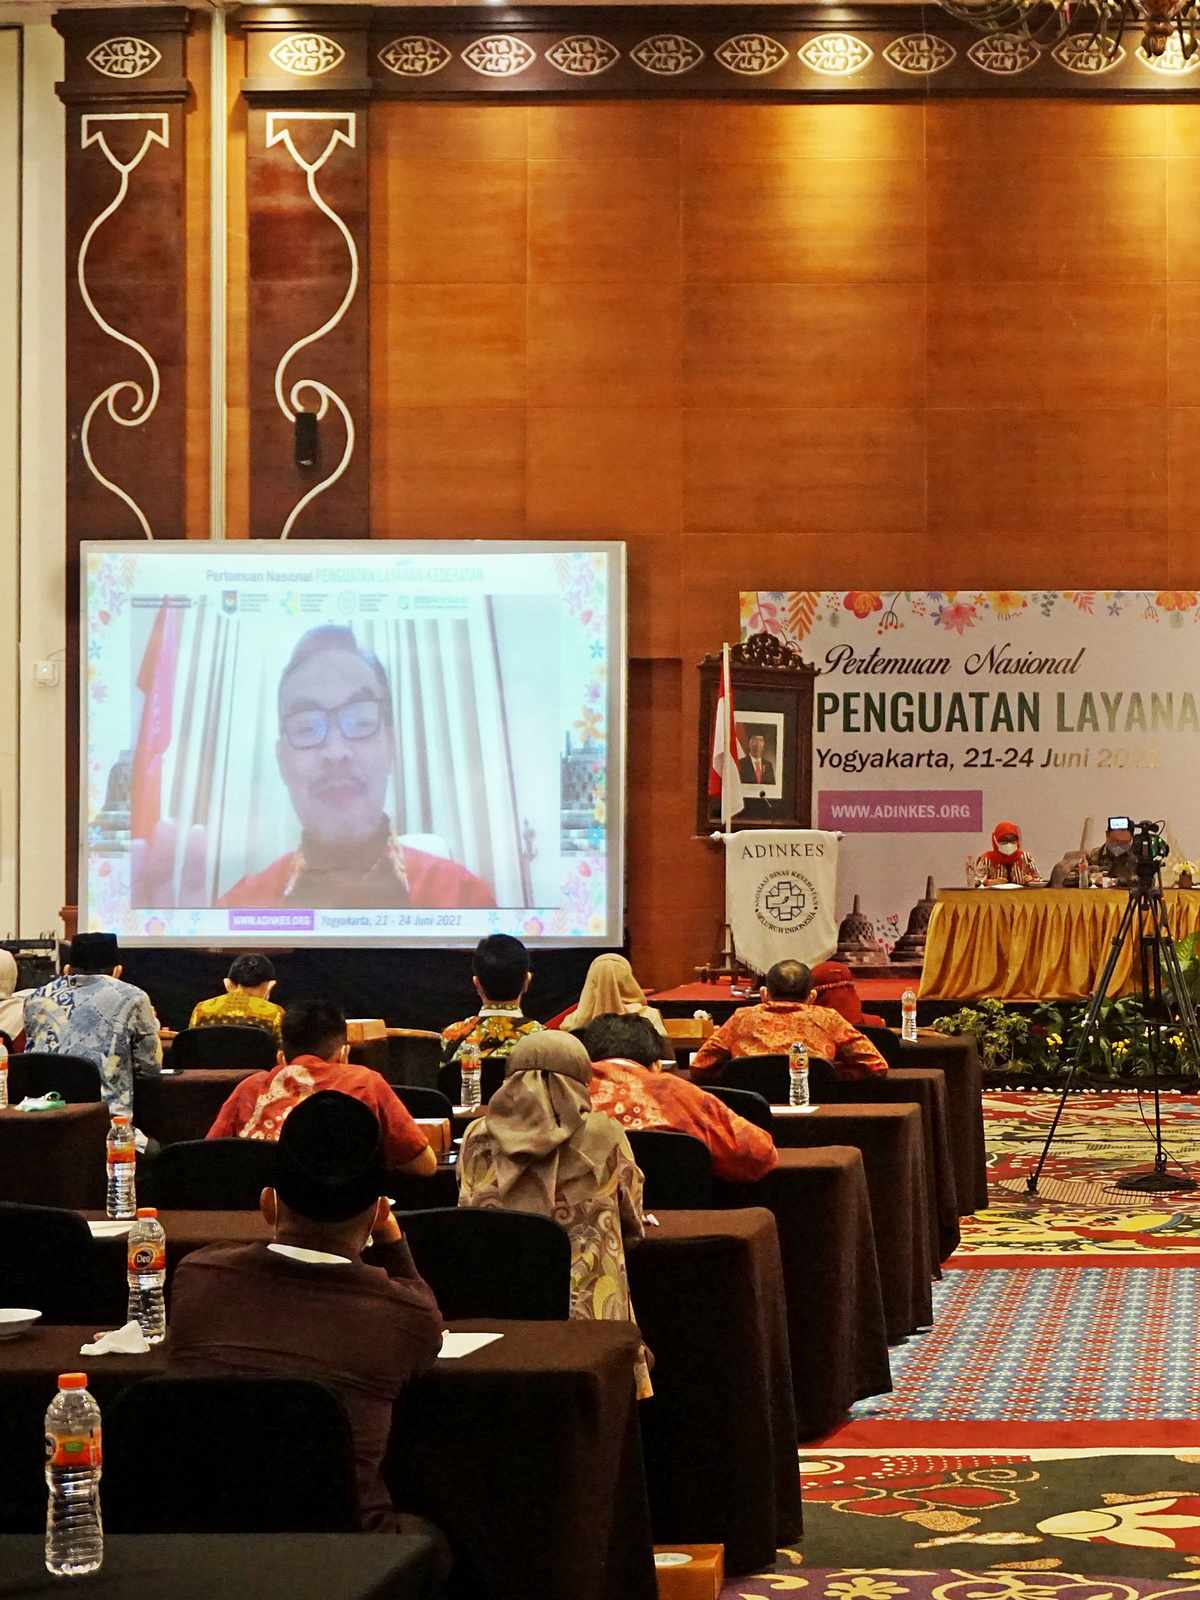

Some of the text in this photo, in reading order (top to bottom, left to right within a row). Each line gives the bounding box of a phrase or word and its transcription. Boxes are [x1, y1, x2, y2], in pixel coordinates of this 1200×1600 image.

[820, 643, 1087, 675] Pertemuan Nasional
[816, 691, 1040, 733] PENGUATAN
[816, 748, 955, 773] Yogyakarta,
[963, 748, 1034, 768] 21-24
[1040, 748, 1089, 768] Juni
[831, 804, 971, 819] WWW.ADINKES.ORG
[741, 843, 825, 859] ADINKES
[397, 914, 411, 926] 24
[414, 914, 433, 926] Juni
[435, 914, 463, 926] 2021
